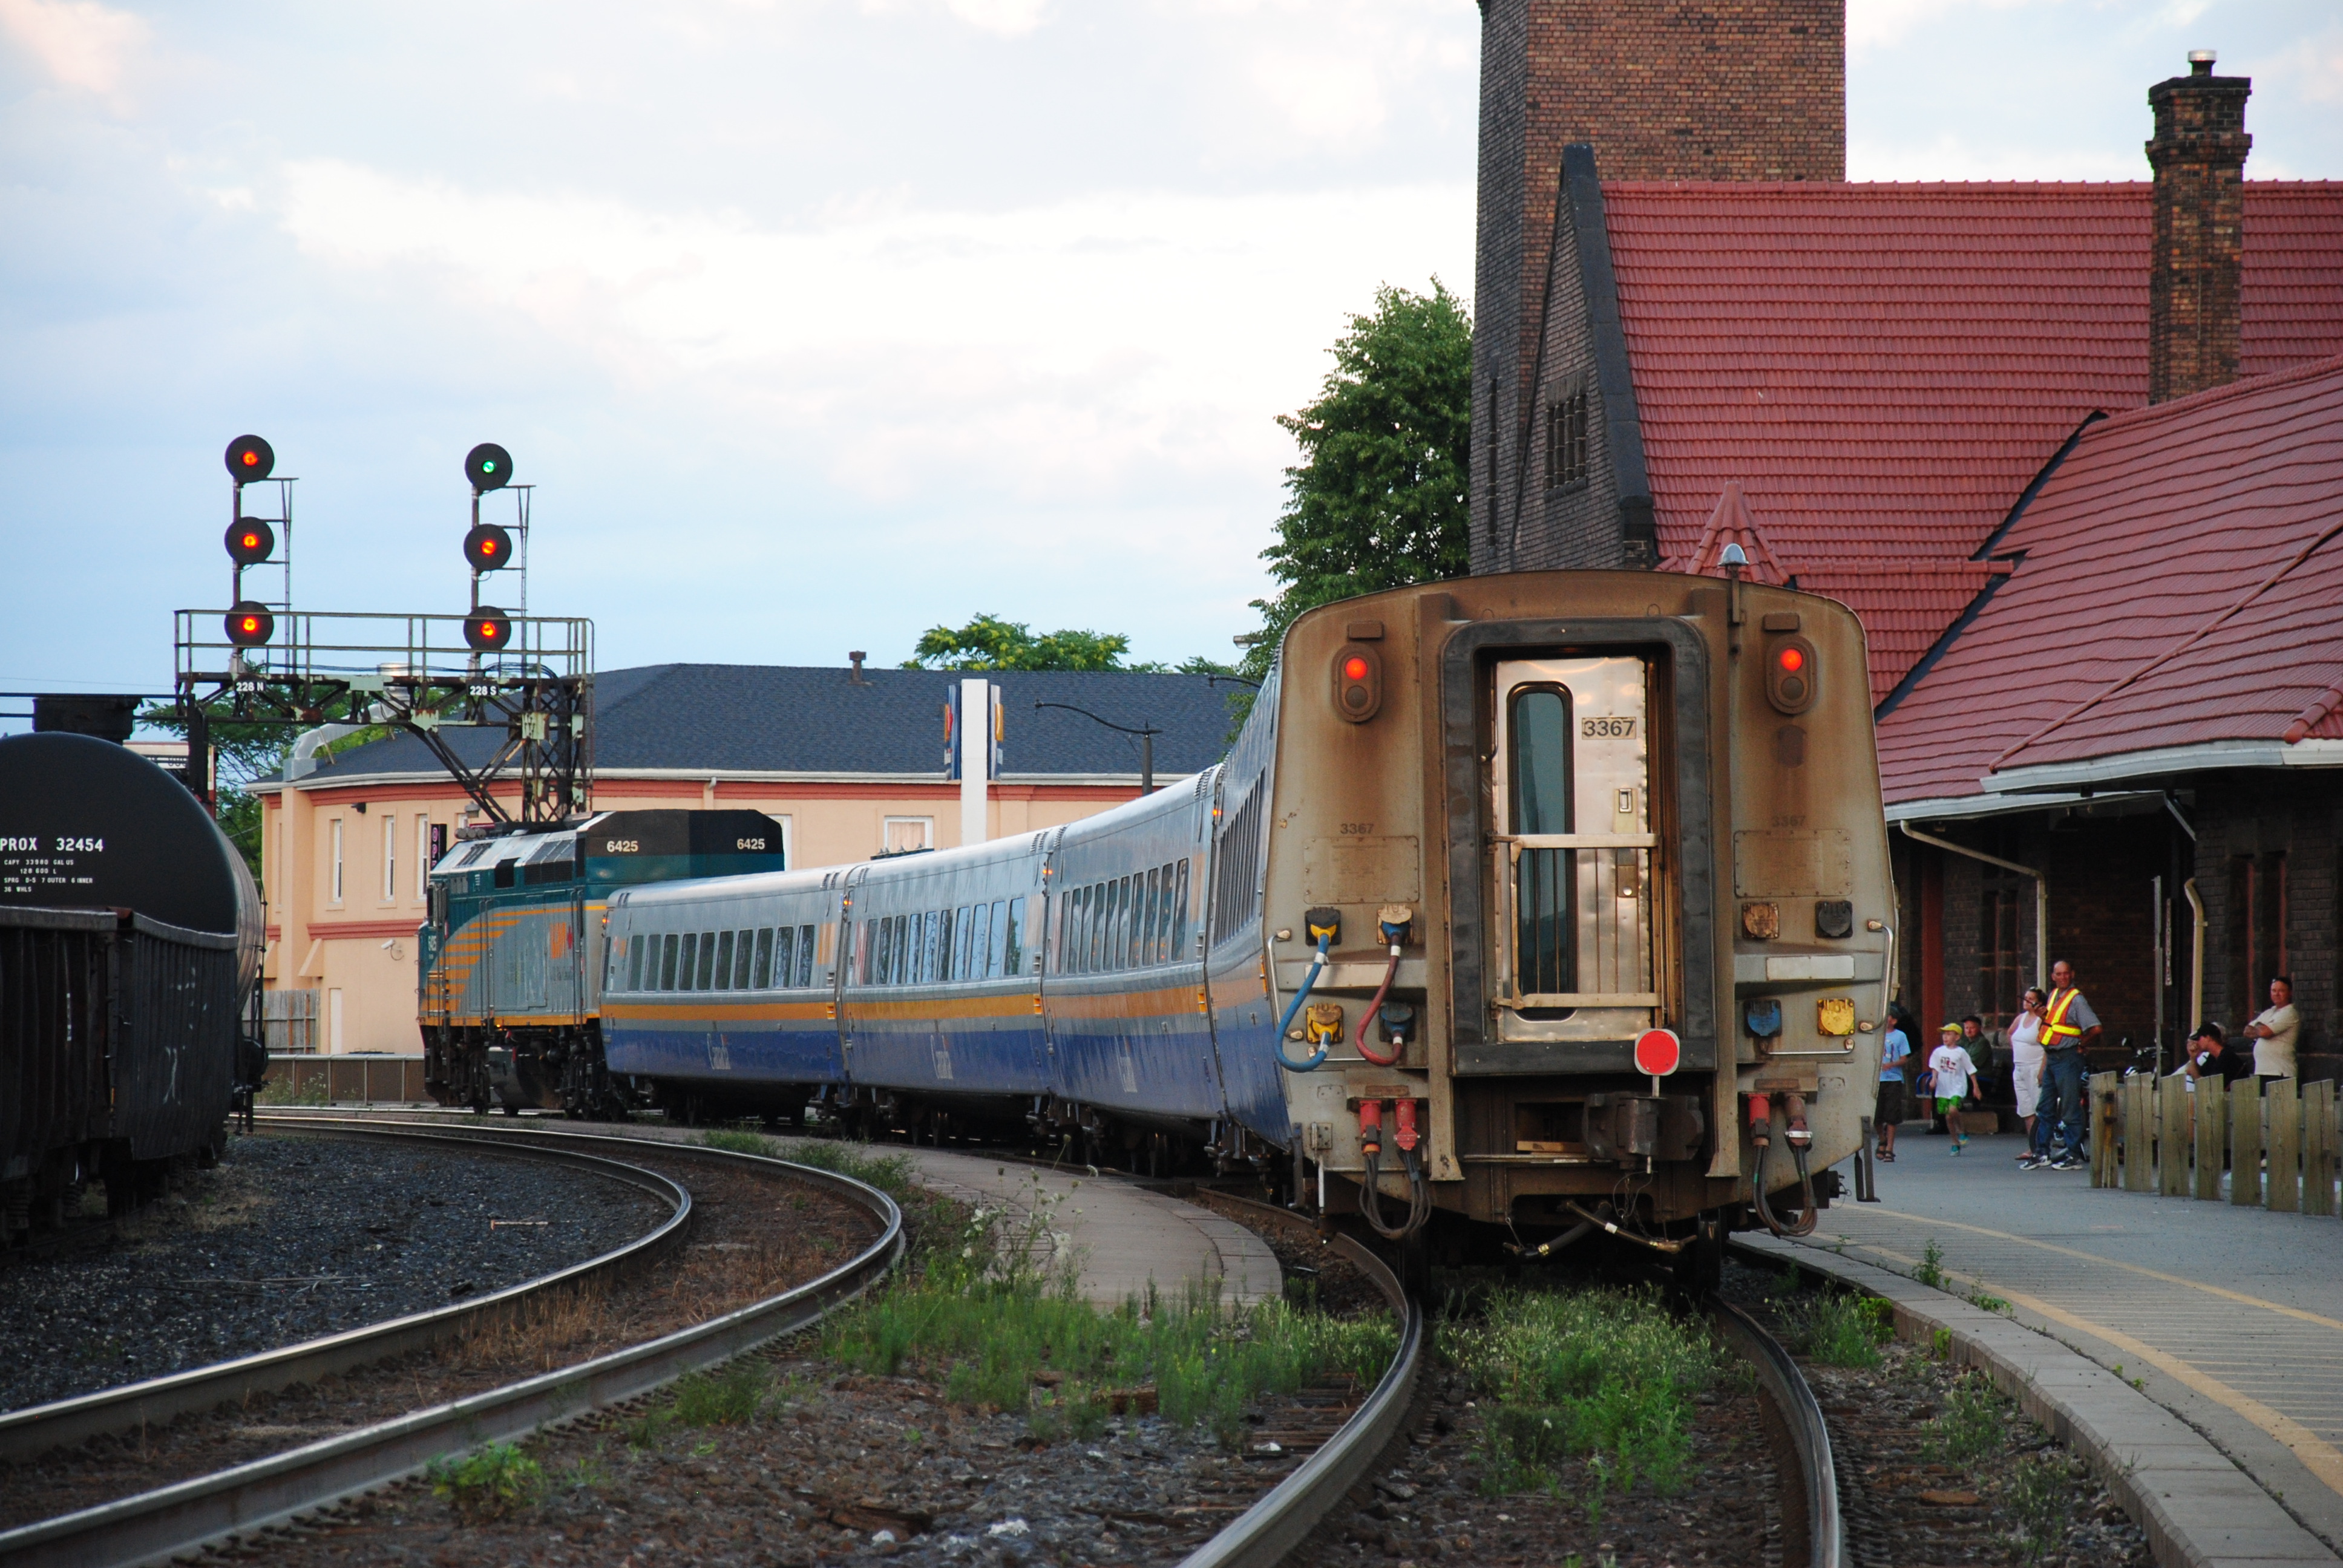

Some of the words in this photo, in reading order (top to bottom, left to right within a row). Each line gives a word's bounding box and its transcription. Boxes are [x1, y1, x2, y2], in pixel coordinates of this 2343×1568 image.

[236, 682, 255, 691] 228
[257, 682, 264, 691] N
[470, 685, 488, 696] 228
[490, 685, 497, 696] S
[1583, 720, 1635, 736] 3367
[1772, 815, 1806, 827] 3367
[1340, 823, 1374, 834] 3367
[0, 837, 38, 851] PROX
[56, 837, 103, 852] 32454
[606, 840, 638, 852] 6425
[737, 838, 765, 850] 6425
